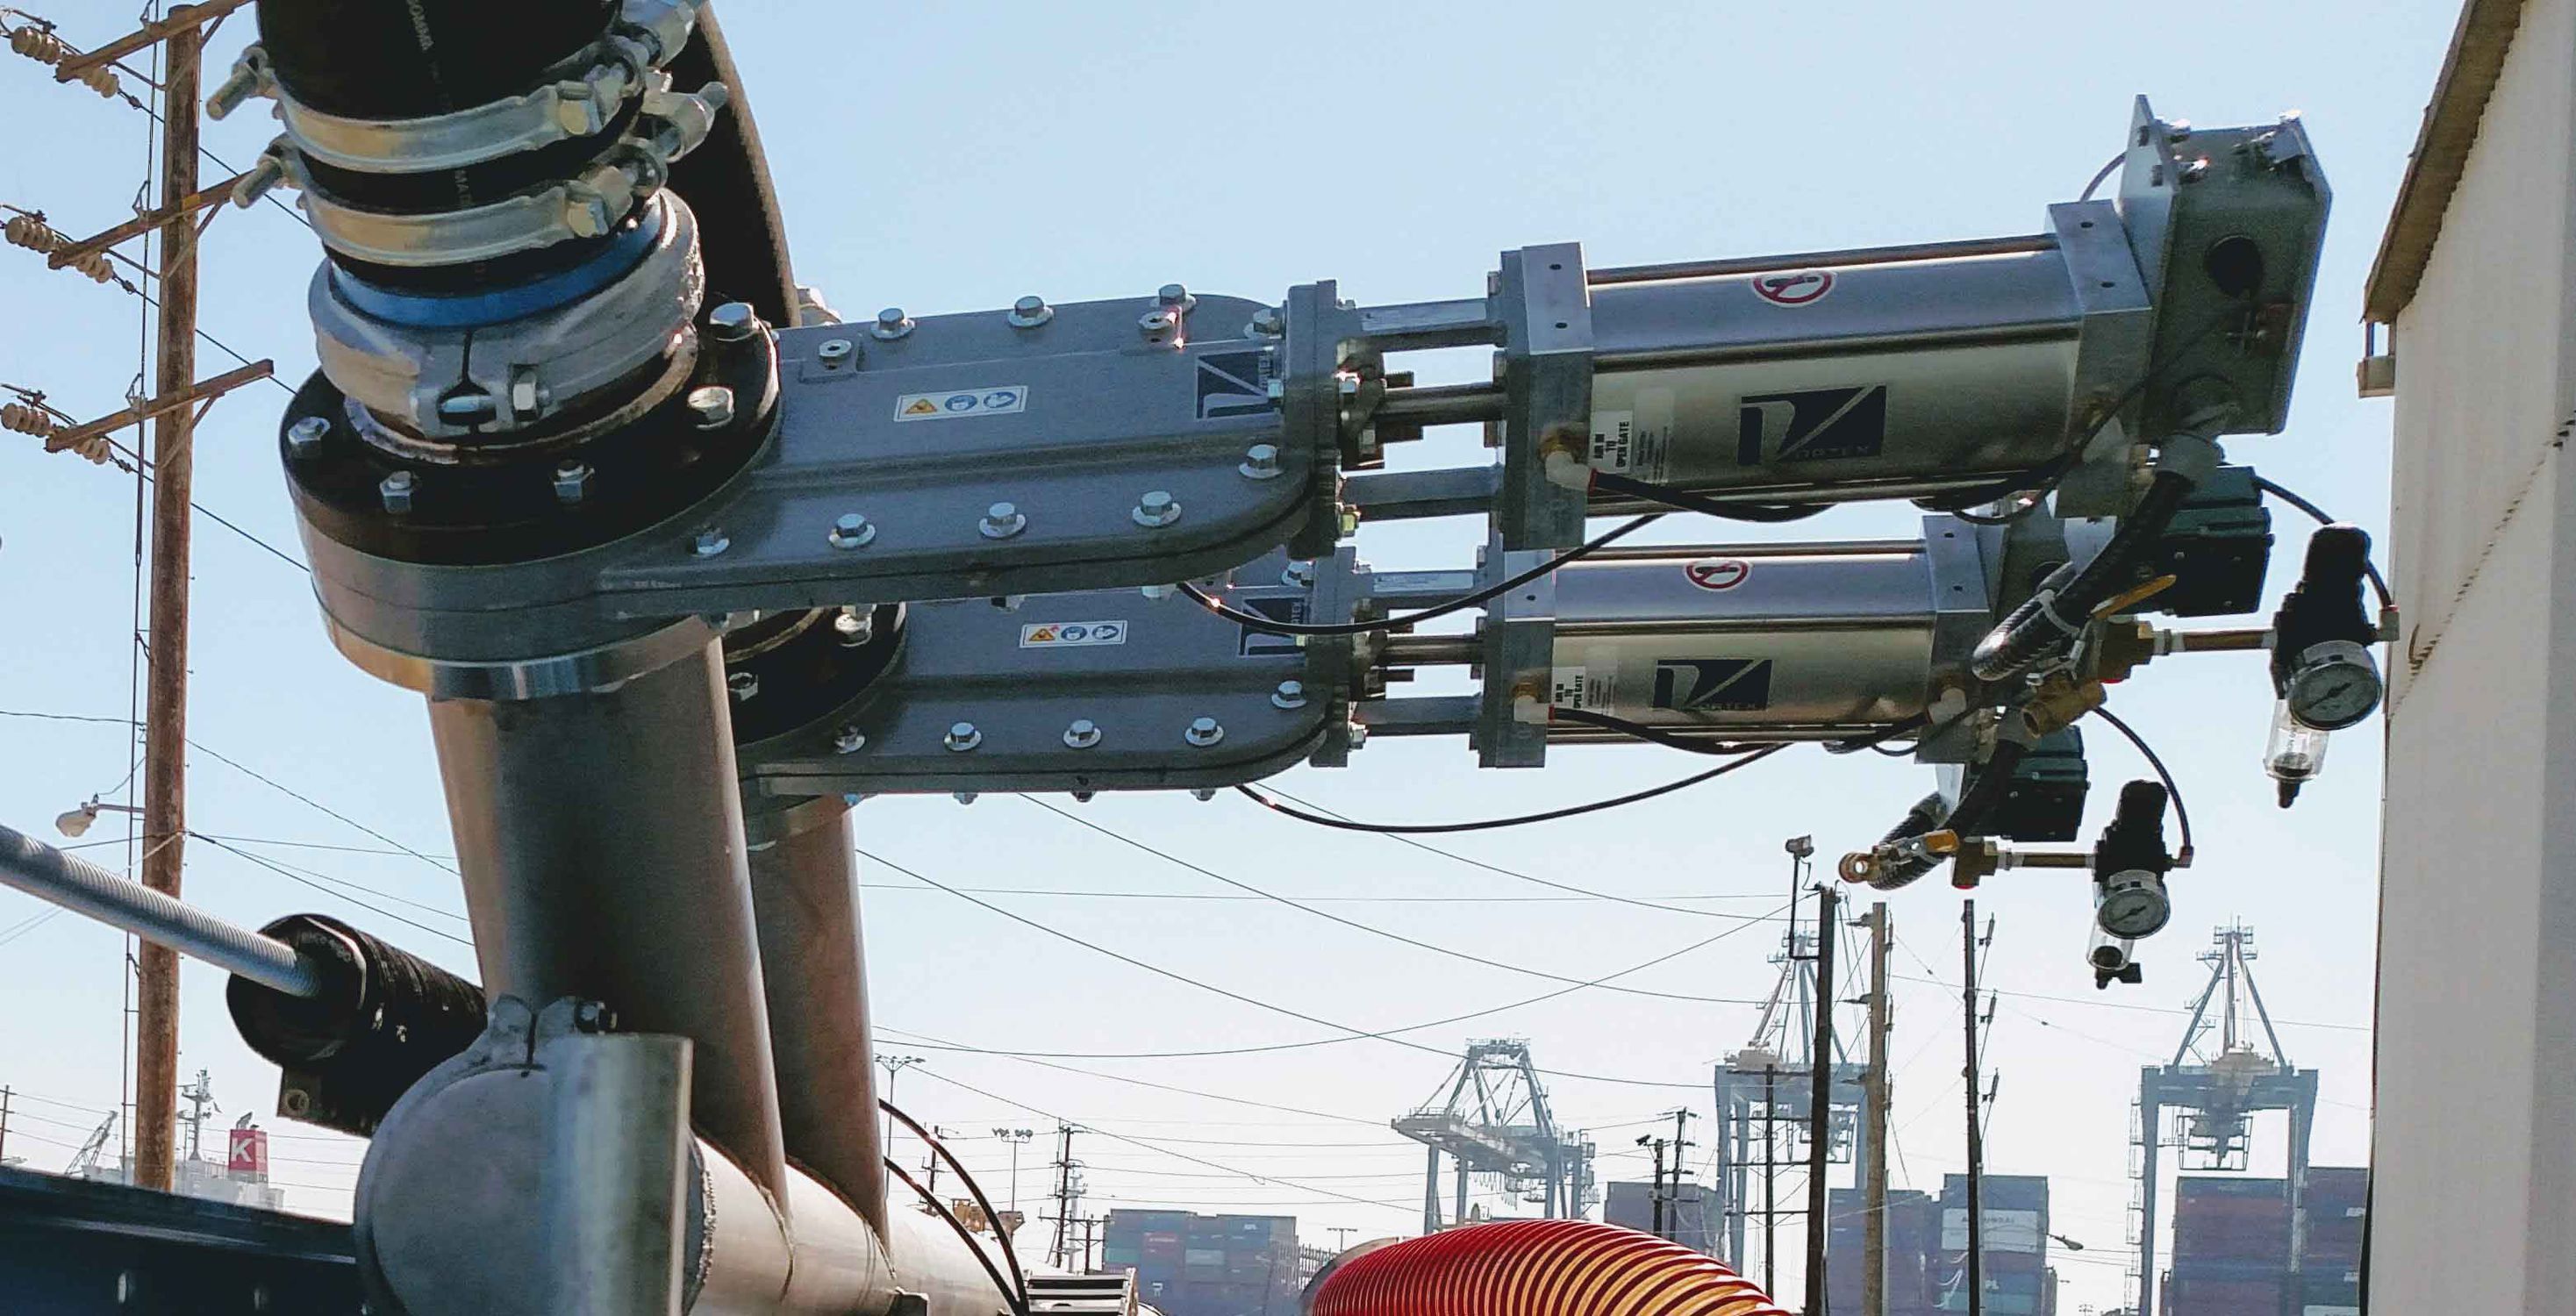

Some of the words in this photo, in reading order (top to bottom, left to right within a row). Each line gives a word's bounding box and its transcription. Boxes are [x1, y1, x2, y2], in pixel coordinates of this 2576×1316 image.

[1618, 421, 1630, 445] GATE
[1606, 440, 1617, 453] TO
[1615, 447, 1628, 468] OPEN
[1575, 675, 1584, 692] GATE
[231, 1138, 252, 1162] K
